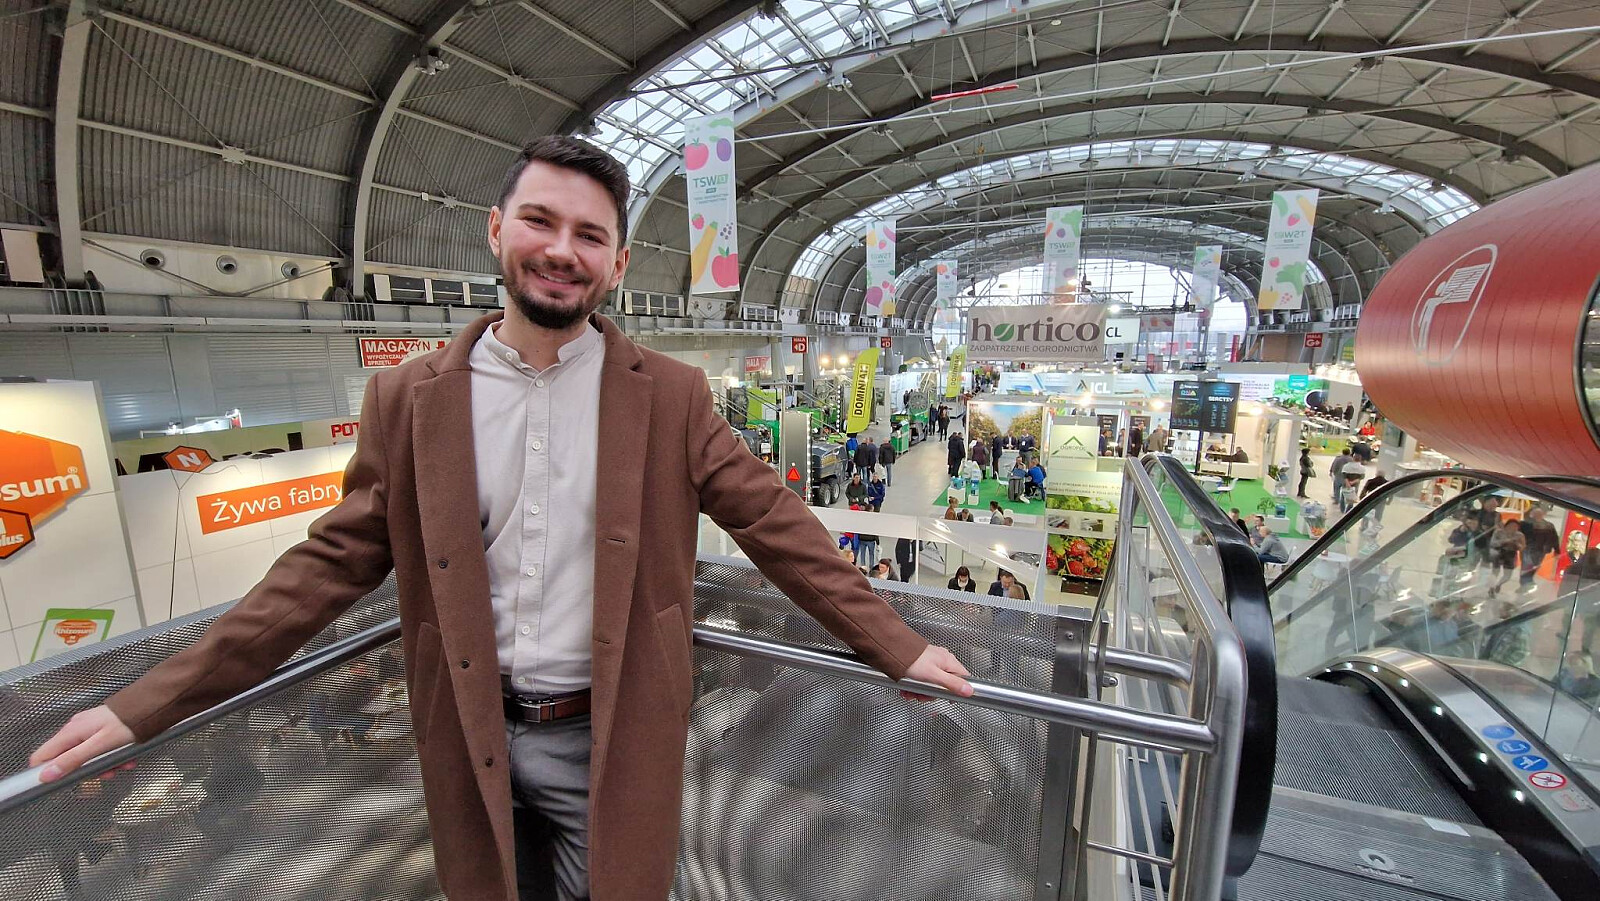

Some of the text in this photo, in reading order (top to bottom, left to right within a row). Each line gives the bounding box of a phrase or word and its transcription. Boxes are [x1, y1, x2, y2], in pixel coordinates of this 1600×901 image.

[971, 317, 1100, 342] hortico
[364, 340, 431, 353] MAGAZYN
[798, 343, 805, 351] D
[969, 345, 1098, 353] ZAOPATRZENIE OGRODNICTWA
[179, 452, 201, 468] N
[0, 474, 82, 502] sum
[210, 498, 282, 523] Żywa
